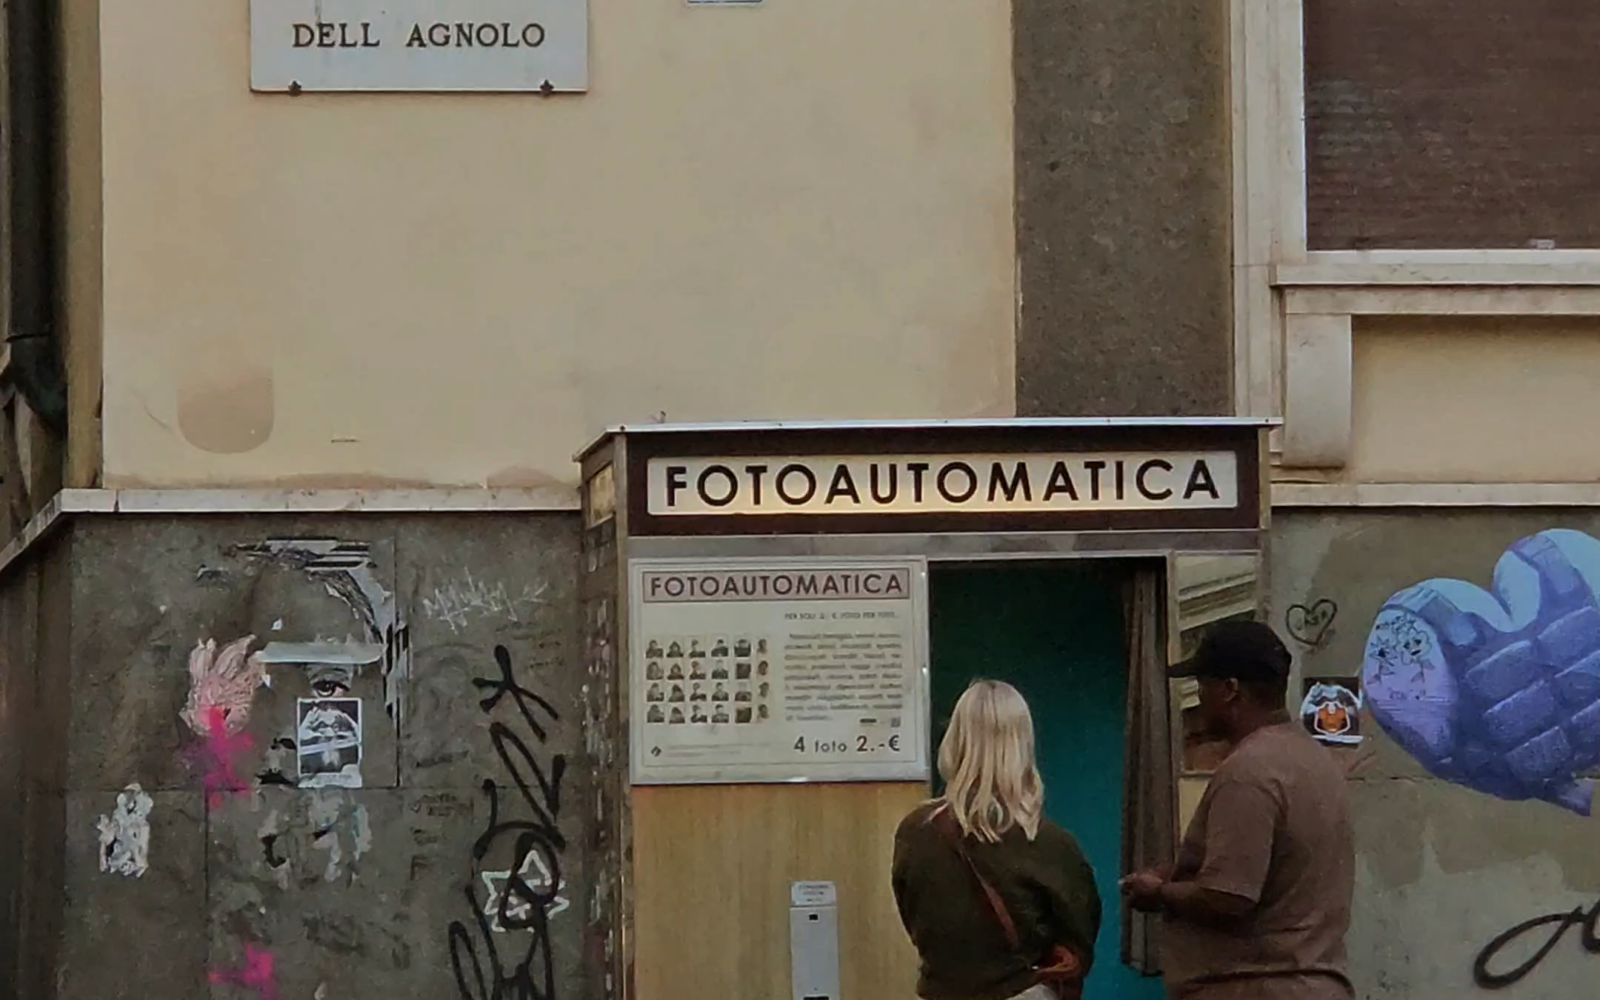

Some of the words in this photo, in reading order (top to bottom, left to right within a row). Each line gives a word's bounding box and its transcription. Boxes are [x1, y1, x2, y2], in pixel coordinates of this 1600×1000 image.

[292, 22, 380, 48] DELL
[405, 22, 546, 48] AGNOLO
[665, 458, 1221, 507] FOTOAUTOMATICA
[650, 573, 903, 597] FOTOAUTOMATICA
[793, 736, 805, 752] 4
[814, 739, 848, 752] foto
